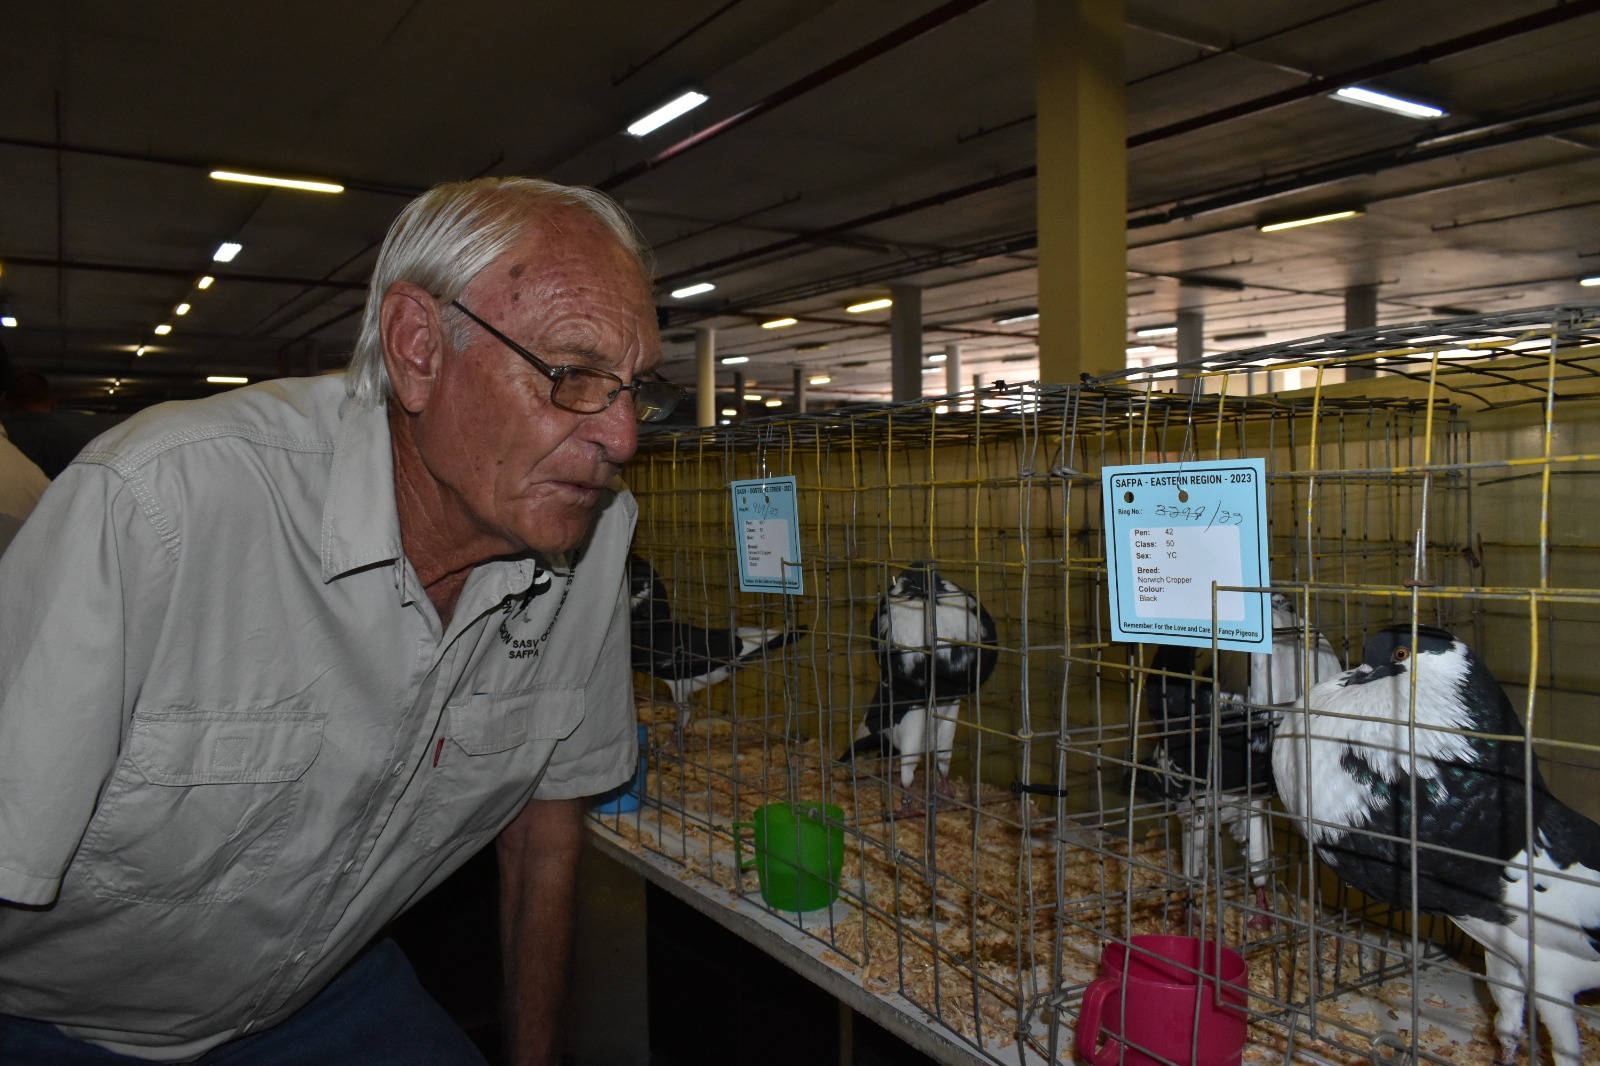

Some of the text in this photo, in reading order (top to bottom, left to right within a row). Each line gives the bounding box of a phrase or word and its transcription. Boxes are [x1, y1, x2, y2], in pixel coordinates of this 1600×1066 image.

[1115, 478, 1143, 488] SAFPA
[1150, 476, 1188, 487] EASTERN
[1190, 474, 1222, 485] REGION
[1230, 473, 1252, 484] 2023
[1117, 508, 1131, 517] Ring
[1164, 528, 1174, 536] 42
[1135, 540, 1157, 548] Class:
[1136, 551, 1177, 560] Sex: YC
[1137, 576, 1192, 585] Norwich Cropper
[1138, 585, 1165, 593] Colour:
[1123, 621, 1154, 630] Remember:
[1173, 624, 1187, 632] Love
[1187, 625, 1198, 633] and
[1198, 626, 1211, 634] Care
[1218, 628, 1235, 637] Fancy
[1235, 628, 1259, 638] Pigeons
[512, 640, 540, 649] SASV
[509, 650, 539, 659] SAFPA
